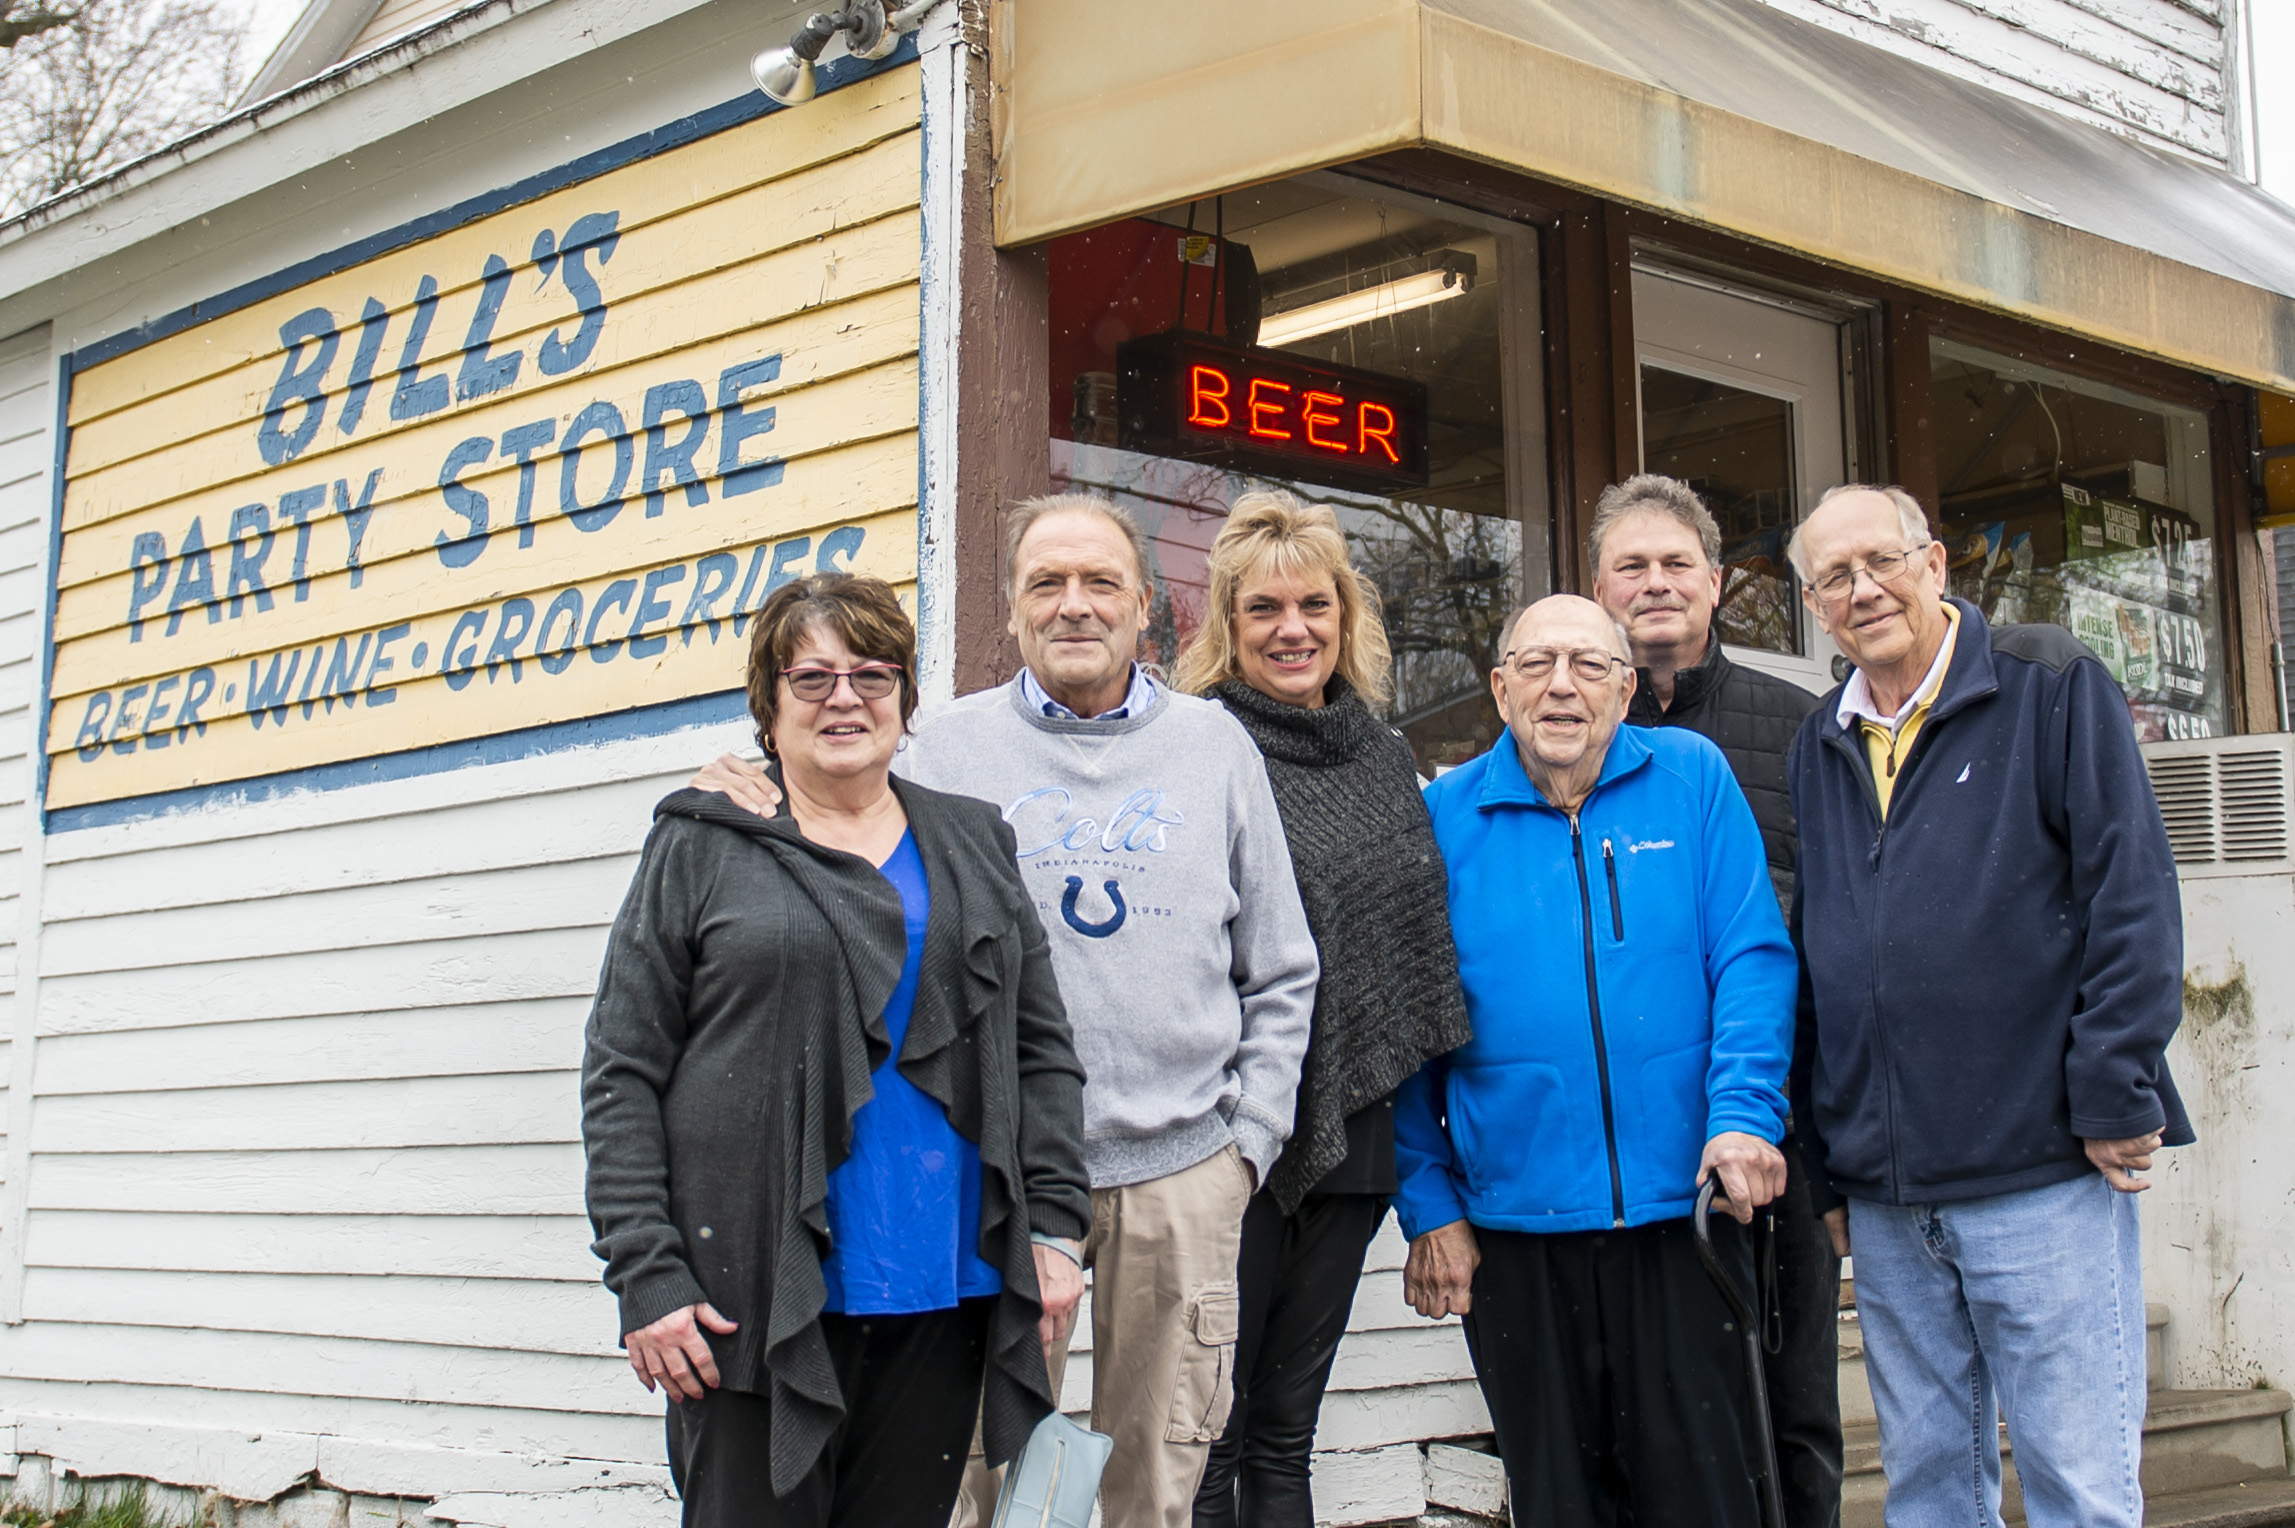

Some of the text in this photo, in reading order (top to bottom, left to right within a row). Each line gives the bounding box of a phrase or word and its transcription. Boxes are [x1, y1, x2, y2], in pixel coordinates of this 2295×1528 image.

[257, 210, 622, 467] BILL'S
[1188, 365, 1400, 464] BEER
[127, 353, 788, 644] PARTY STORE
[2105, 520, 2141, 549] MENTHOL
[2077, 613, 2114, 639] INTENSE
[2160, 615, 2206, 672] $7.50
[74, 666, 215, 763] BEER
[246, 621, 412, 731] WINE
[2127, 662, 2149, 678] KOOL
[2175, 677, 2204, 695] INCLUDED
[1002, 786, 1185, 858] Colts
[1035, 858, 1146, 873] INDIANAPOLIS
